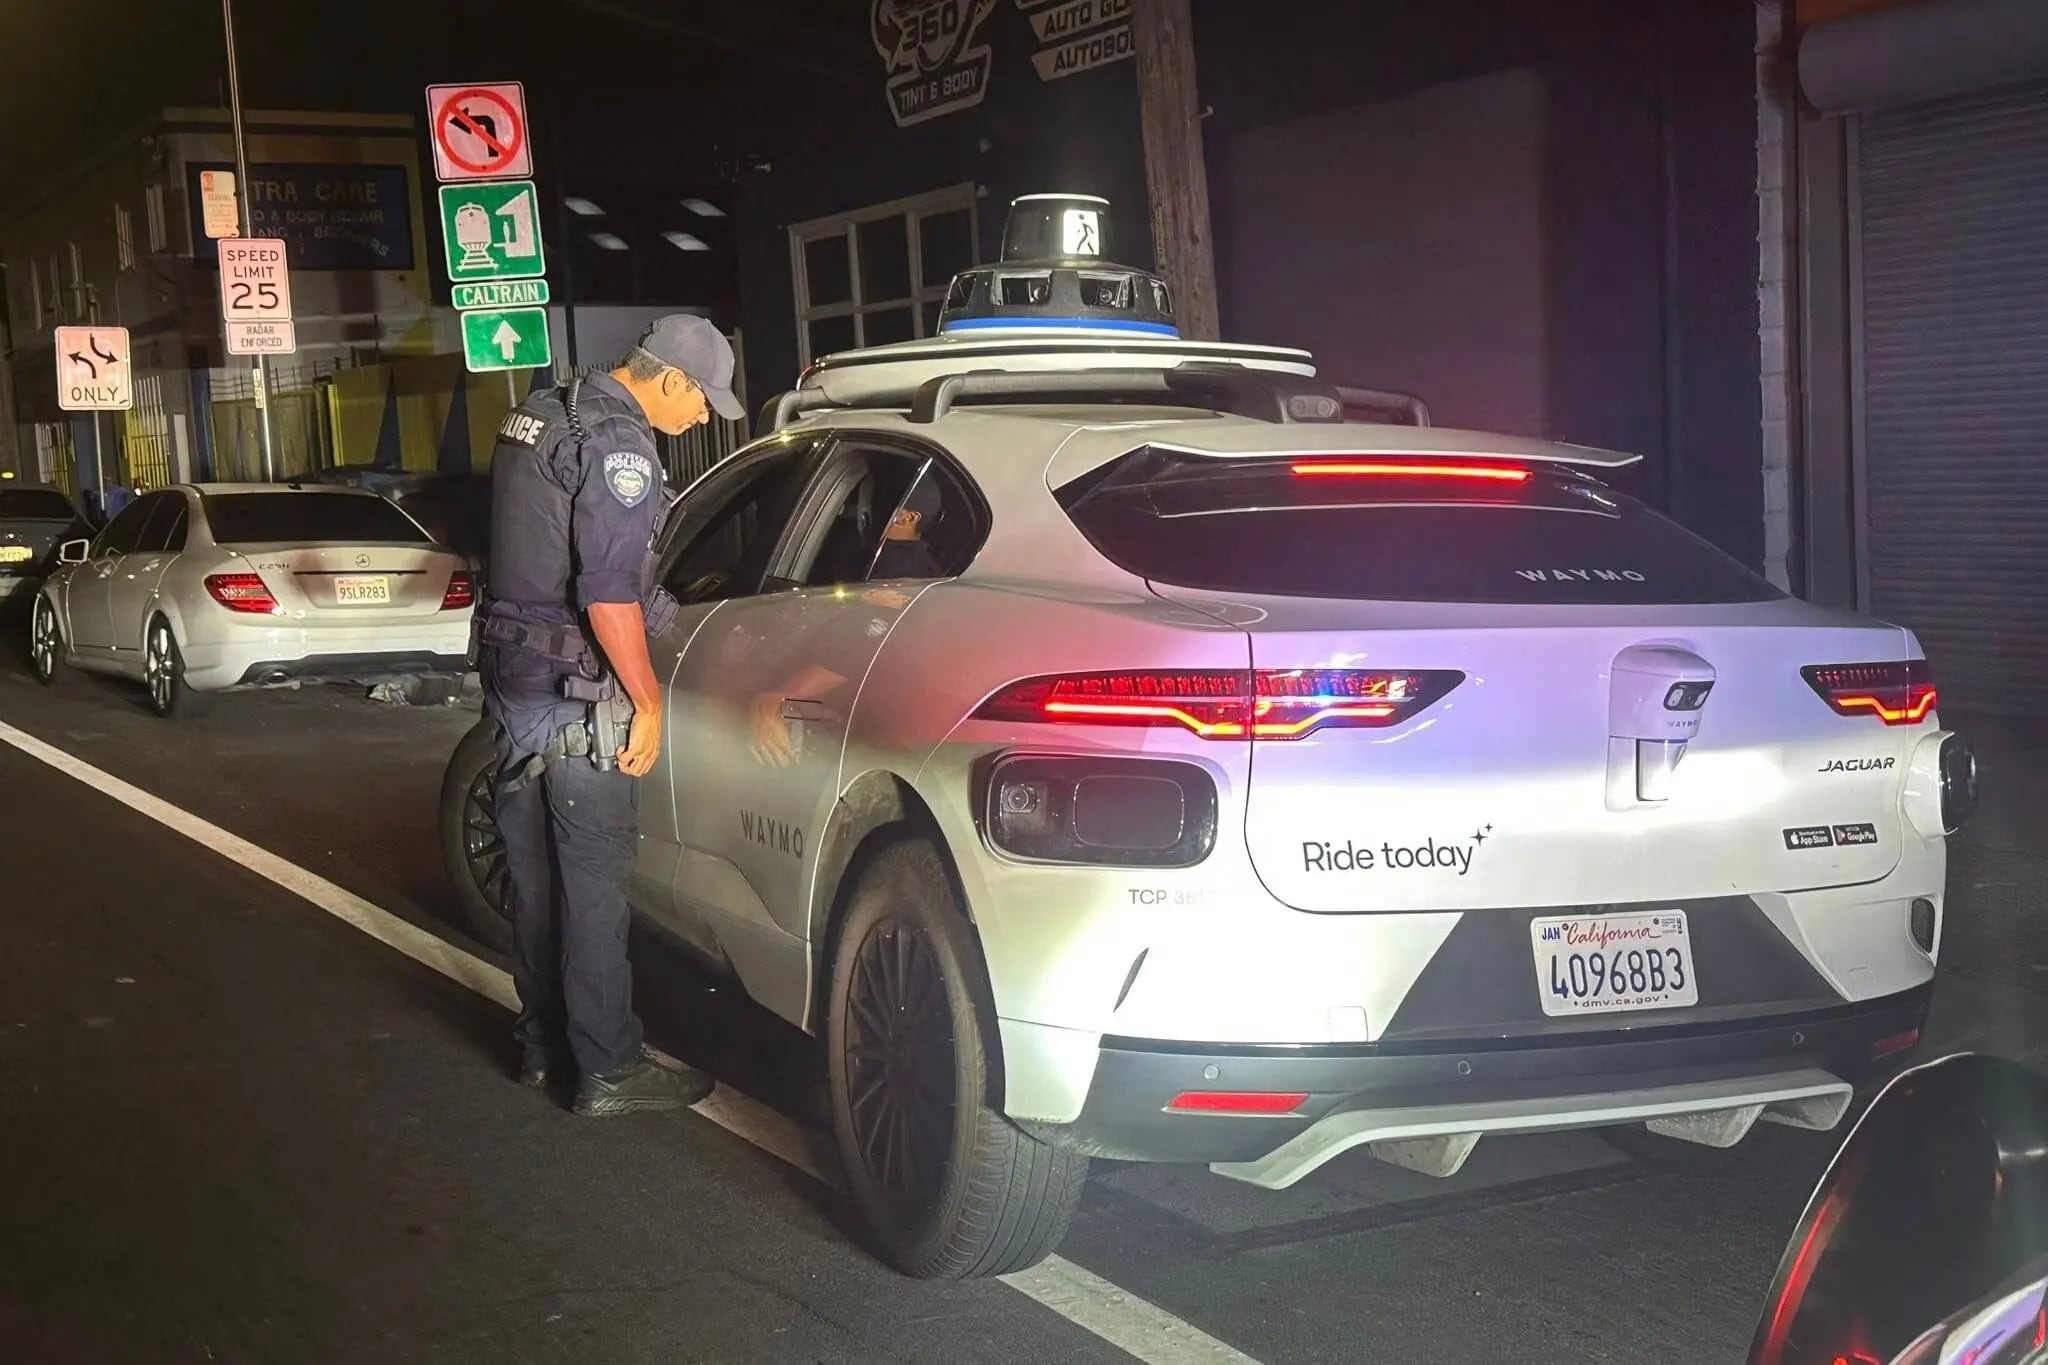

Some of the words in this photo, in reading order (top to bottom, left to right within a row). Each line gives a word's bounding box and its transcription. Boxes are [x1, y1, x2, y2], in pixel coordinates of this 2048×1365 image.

[901, 1, 959, 52] 360
[1044, 1, 1092, 37] AUTO
[900, 84, 927, 112] TINT
[943, 67, 979, 96] BODY
[249, 180, 298, 202] TRA
[227, 250, 279, 261] SPEED
[233, 266, 274, 278] LIMIT
[230, 282, 279, 310] 25
[462, 283, 540, 305] CALTRAIN
[246, 325, 275, 335] RADAR
[241, 337, 283, 347] ENFORCED
[71, 386, 119, 402] ONLY
[498, 412, 545, 445] OLICE
[1515, 569, 1646, 581] WAYMO
[340, 586, 386, 600] 9SLR283
[1818, 757, 1896, 772] JAGUAR
[740, 809, 803, 859] WAYMO
[1303, 840, 1374, 872] Ride
[1381, 837, 1473, 875] today
[1128, 889, 1167, 905] TCP
[1541, 926, 1561, 940] JAN
[1567, 921, 1662, 949] California
[1551, 948, 1685, 998] 40968B3
[1582, 995, 1660, 1007] dmv.ca.gov
